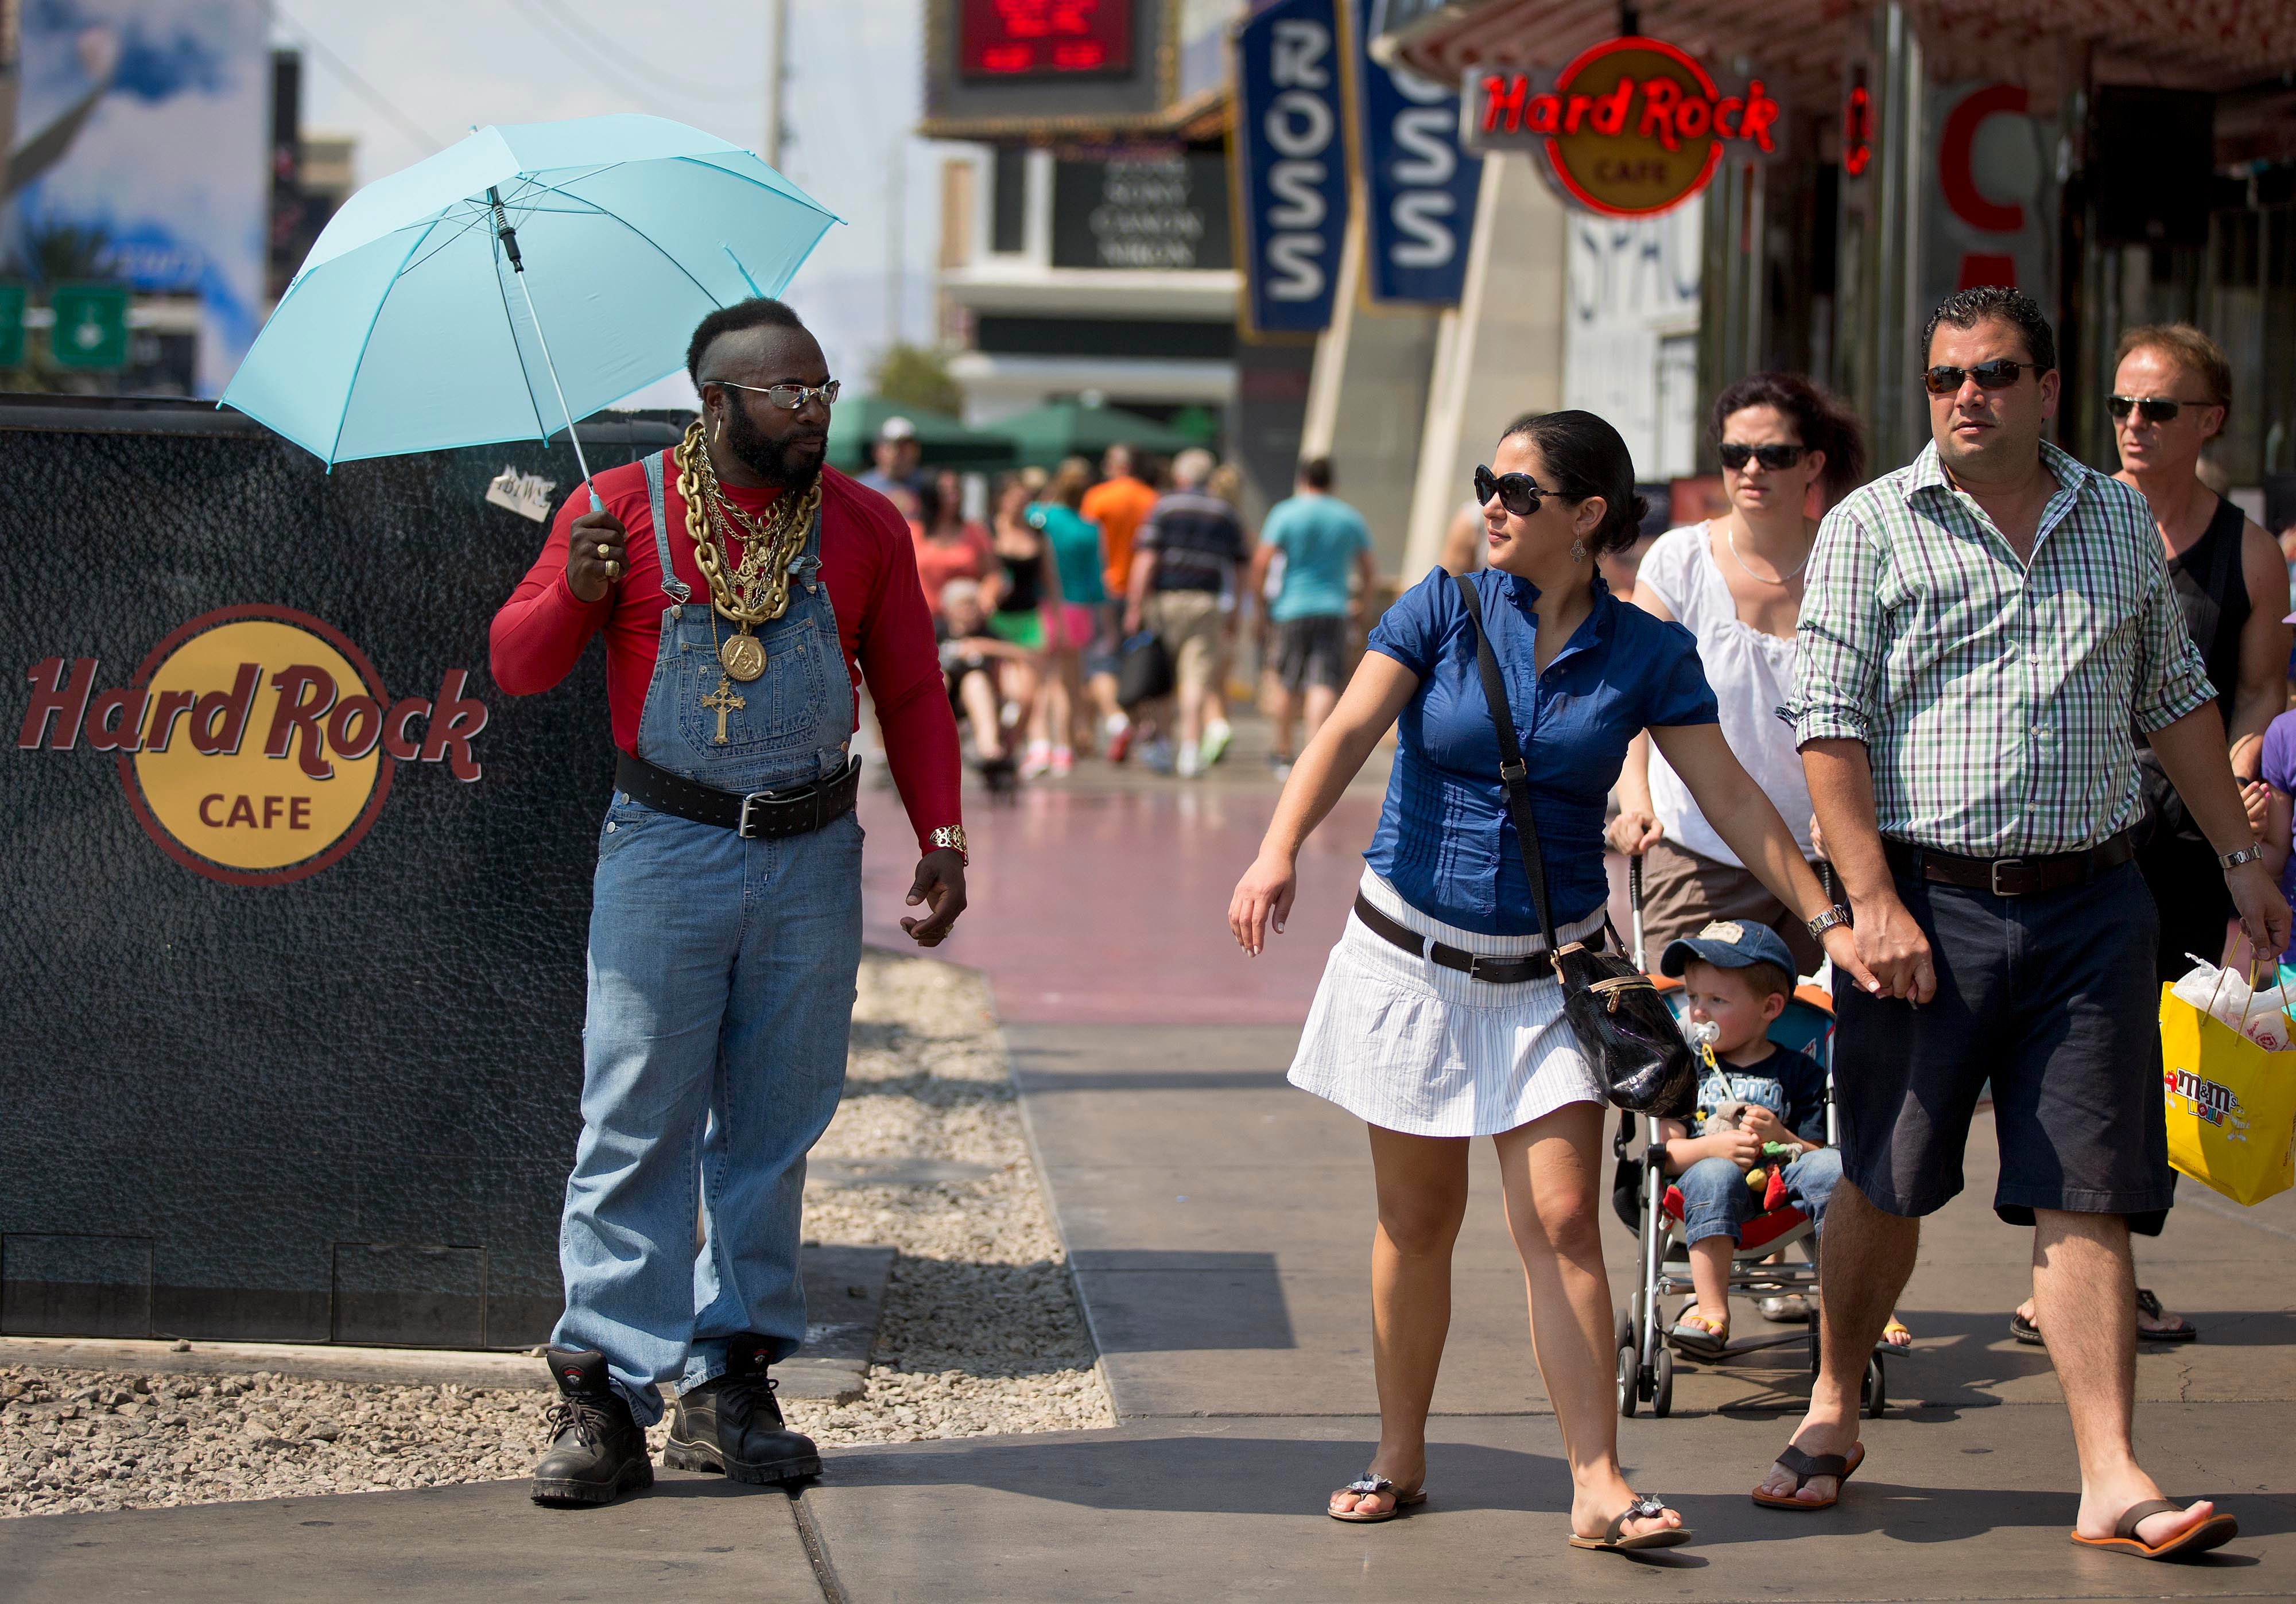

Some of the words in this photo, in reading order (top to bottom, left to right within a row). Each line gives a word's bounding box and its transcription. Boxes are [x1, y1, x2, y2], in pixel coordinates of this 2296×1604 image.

[1263, 19, 1335, 303] ROSS
[1481, 74, 1634, 135] Hard
[1638, 76, 1778, 153] Rock
[18, 657, 262, 755] Hard
[264, 665, 488, 783] Rock
[199, 793, 311, 830] CAFE
